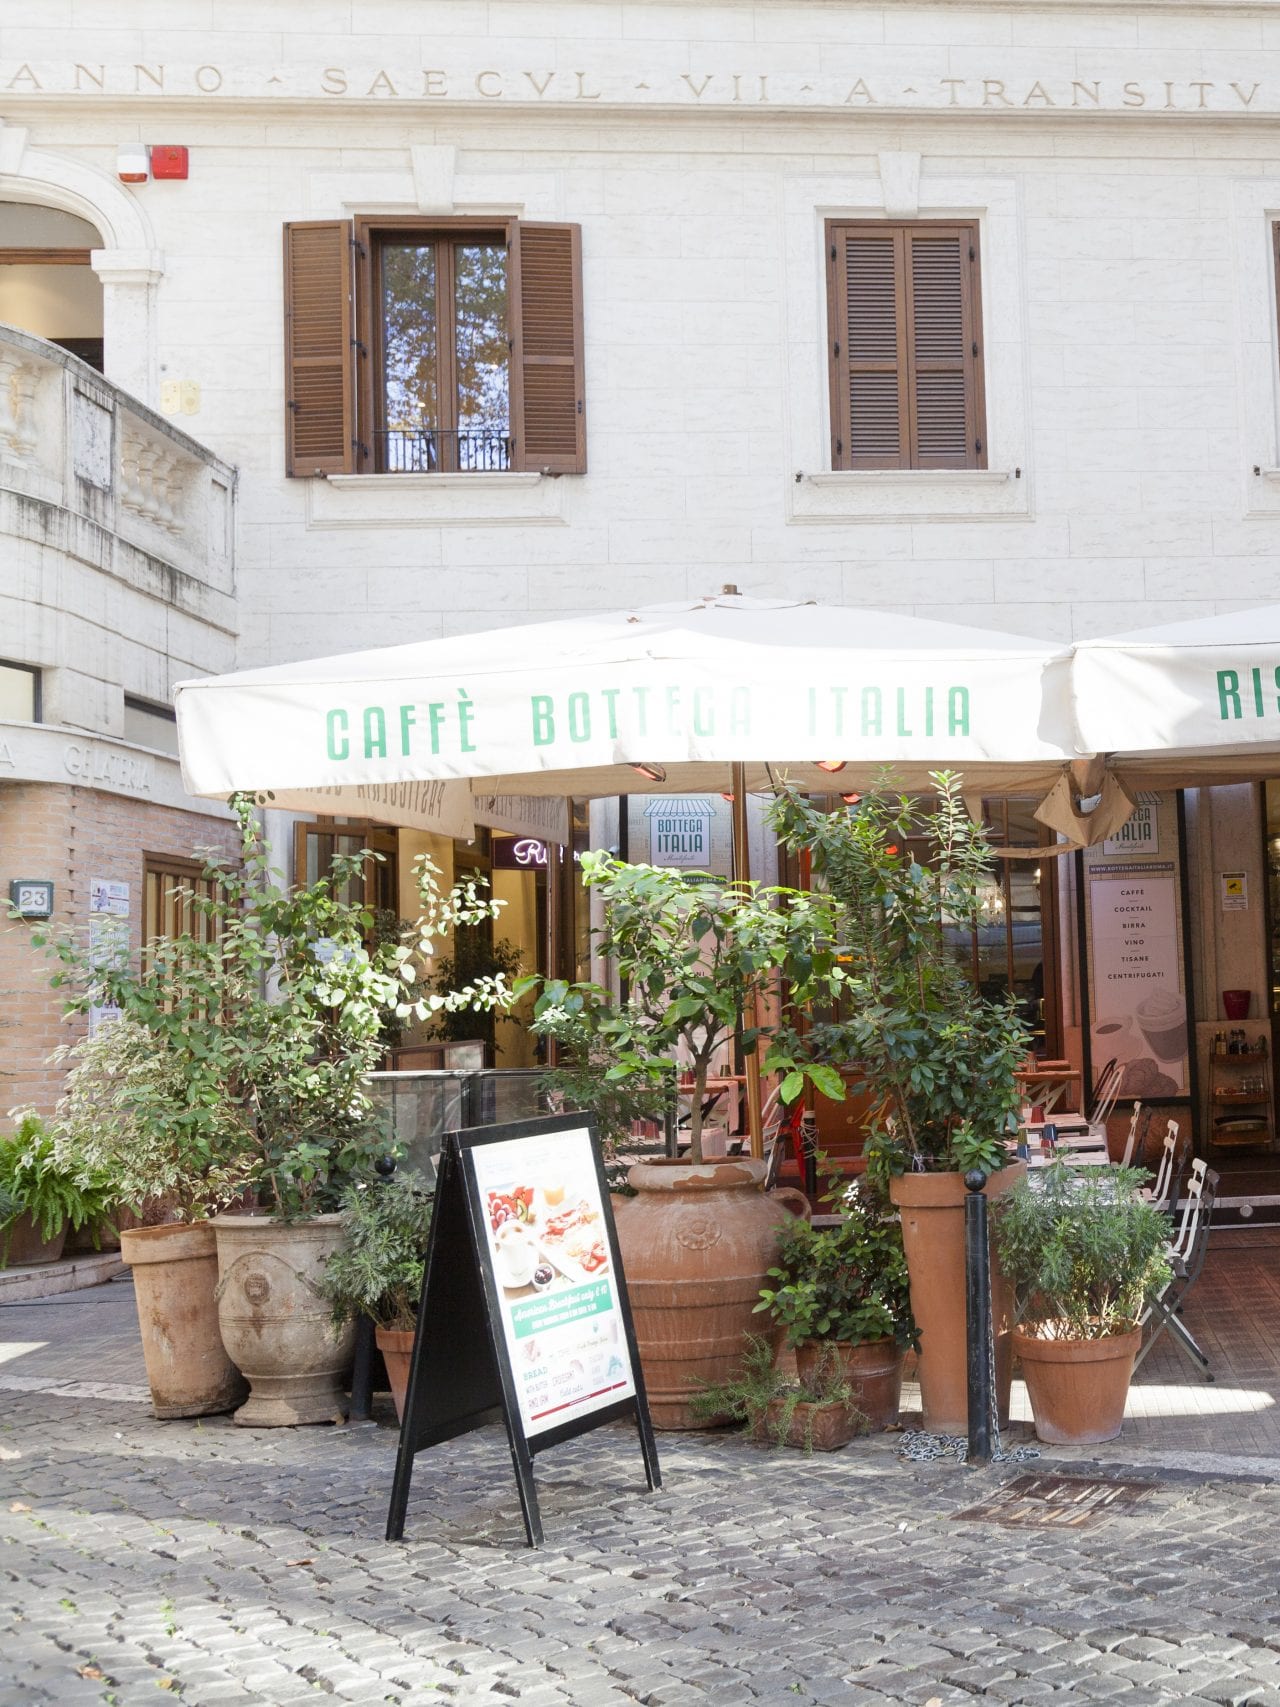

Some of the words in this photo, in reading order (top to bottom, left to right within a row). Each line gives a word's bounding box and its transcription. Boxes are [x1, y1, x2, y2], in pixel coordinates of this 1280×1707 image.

[6, 64, 223, 93] ANNO
[320, 67, 601, 99] SAECVL
[681, 74, 769, 101] VII
[845, 77, 878, 103] A
[940, 79, 1262, 109] TRANSITV
[327, 688, 477, 761] CAFFÈ
[532, 686, 752, 748] BOTTEGA
[807, 686, 971, 737] ITALIA
[658, 819, 703, 832] BOTTEGA
[1110, 823, 1152, 841] ALIA
[658, 834, 703, 852] ITALIA
[21, 890, 46, 906] 23
[1114, 905, 1153, 913] COCKTAIL
[1107, 971, 1164, 980] CENTRIFUGATI
[523, 1366, 549, 1381] BREAD
